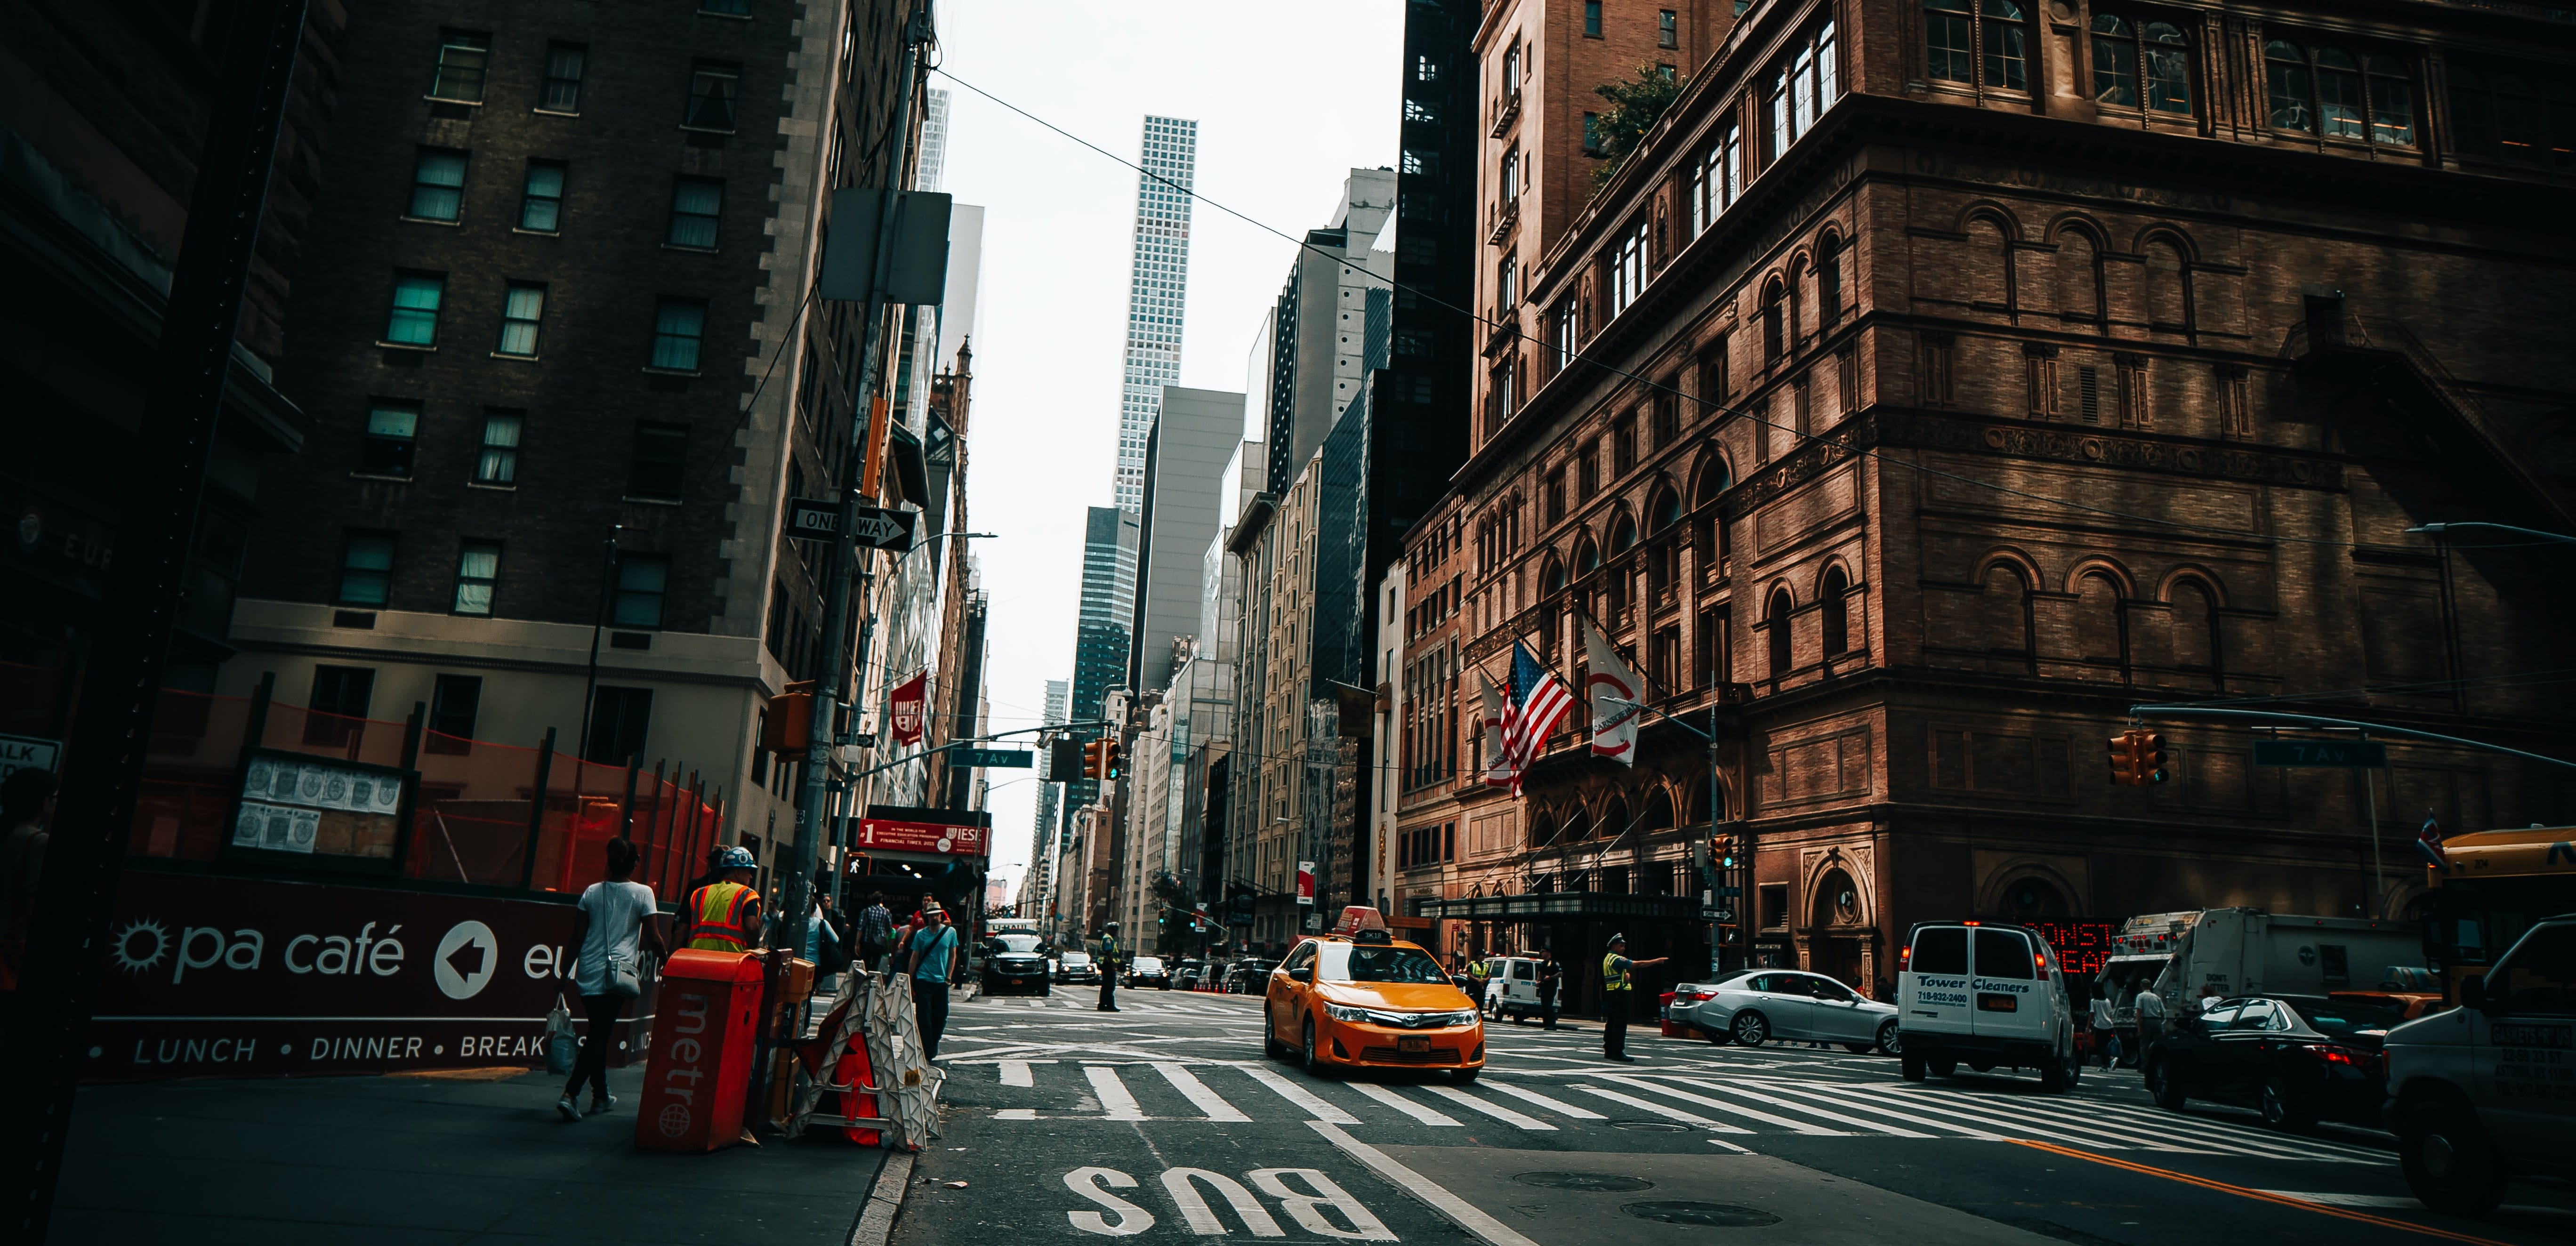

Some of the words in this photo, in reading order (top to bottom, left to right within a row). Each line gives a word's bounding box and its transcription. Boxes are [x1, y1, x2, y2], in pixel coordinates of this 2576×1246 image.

[858, 520, 894, 537] WAY
[1594, 709, 1627, 732] CARNEGIE
[0, 744, 36, 762] LK
[976, 753, 983, 763] 7
[989, 753, 1008, 764] Av
[2294, 746, 2306, 761] 7
[2316, 746, 2345, 762] Av
[860, 824, 874, 844] #1
[958, 828, 982, 842] IESE
[285, 921, 404, 976] café
[1917, 975, 1966, 989] Tower
[1972, 978, 2029, 993] Cleaners
[1917, 991, 1967, 1003] 718-932-2400
[2493, 1025, 2536, 1045] GASKETS
[2557, 1028, 2571, 1046] US
[134, 1037, 256, 1064] LUNCH
[311, 1036, 422, 1060] DINNER
[2548, 1051, 2562, 1064] ST
[1063, 1166, 1401, 1242] BUS
